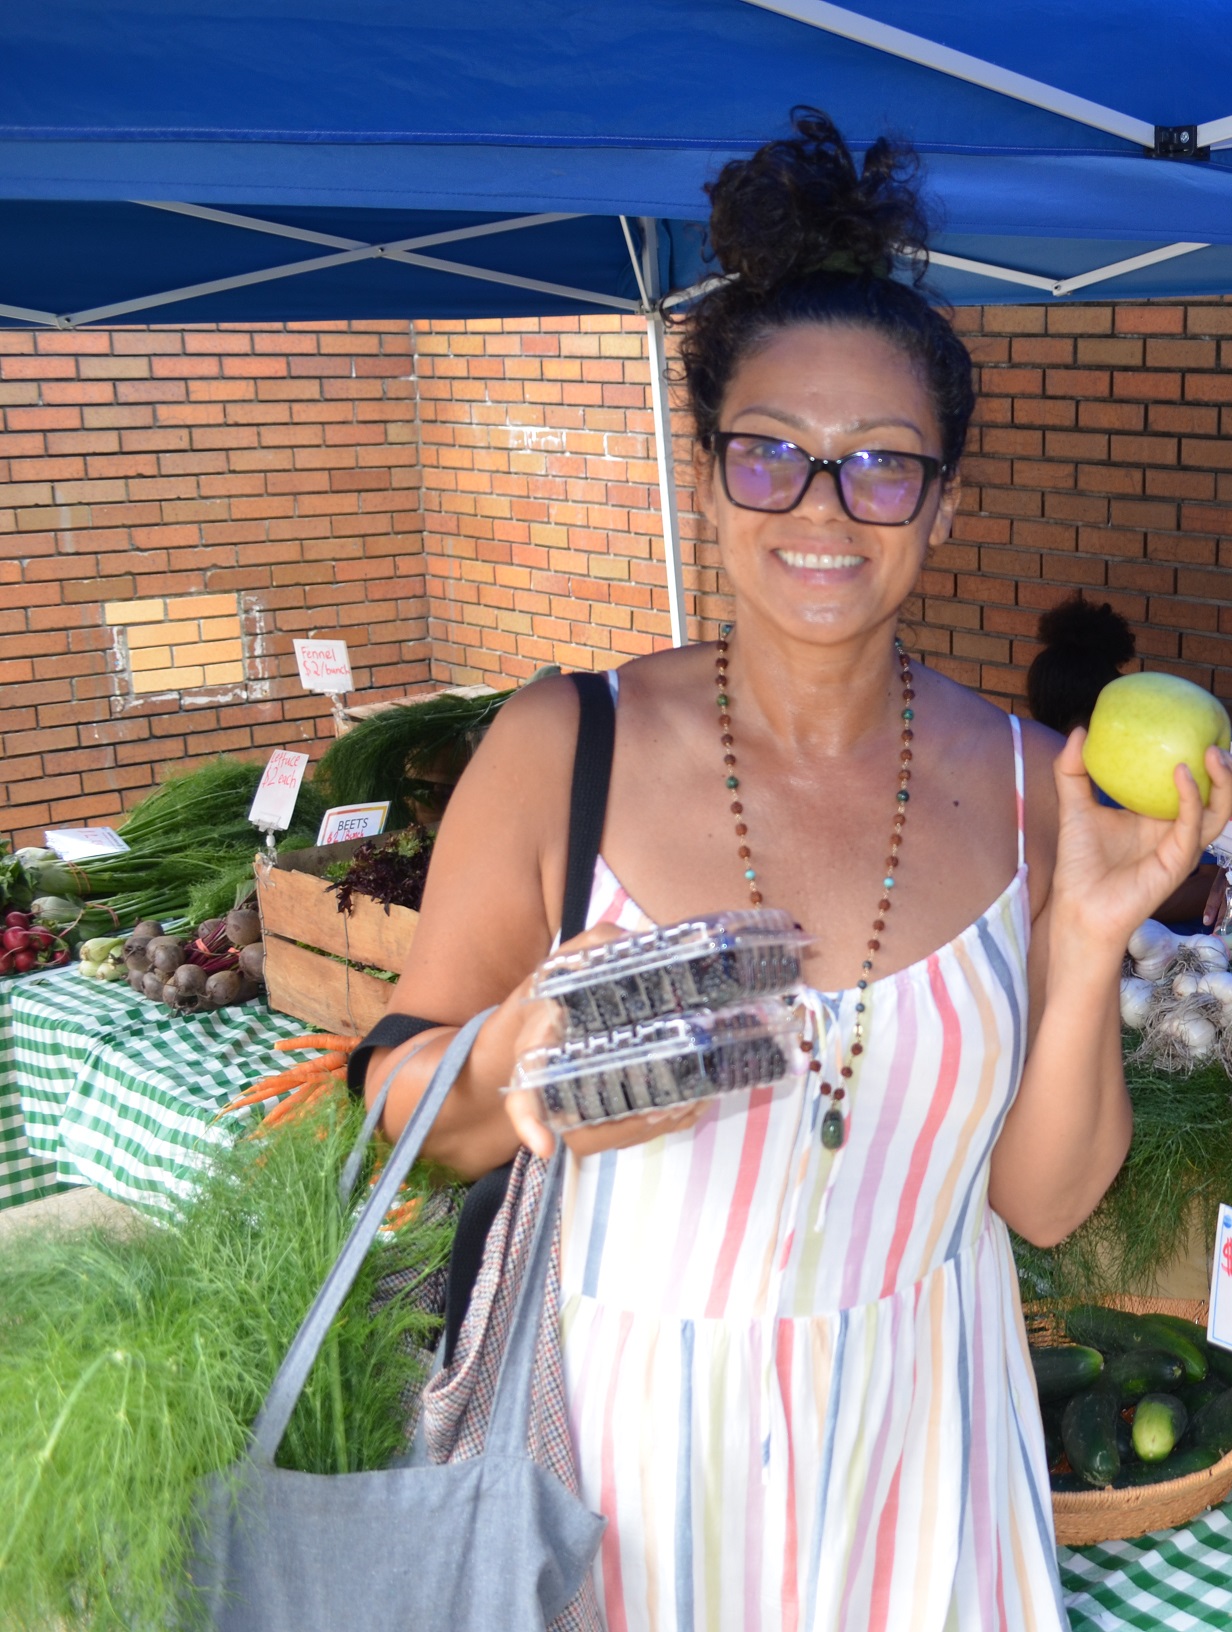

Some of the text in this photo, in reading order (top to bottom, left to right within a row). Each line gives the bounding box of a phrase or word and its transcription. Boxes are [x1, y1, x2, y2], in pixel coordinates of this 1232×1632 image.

[302, 647, 336, 662] Fennel
[302, 661, 350, 677] $2/bunch
[262, 766, 297, 788] $2 each
[338, 817, 369, 831] BEETS
